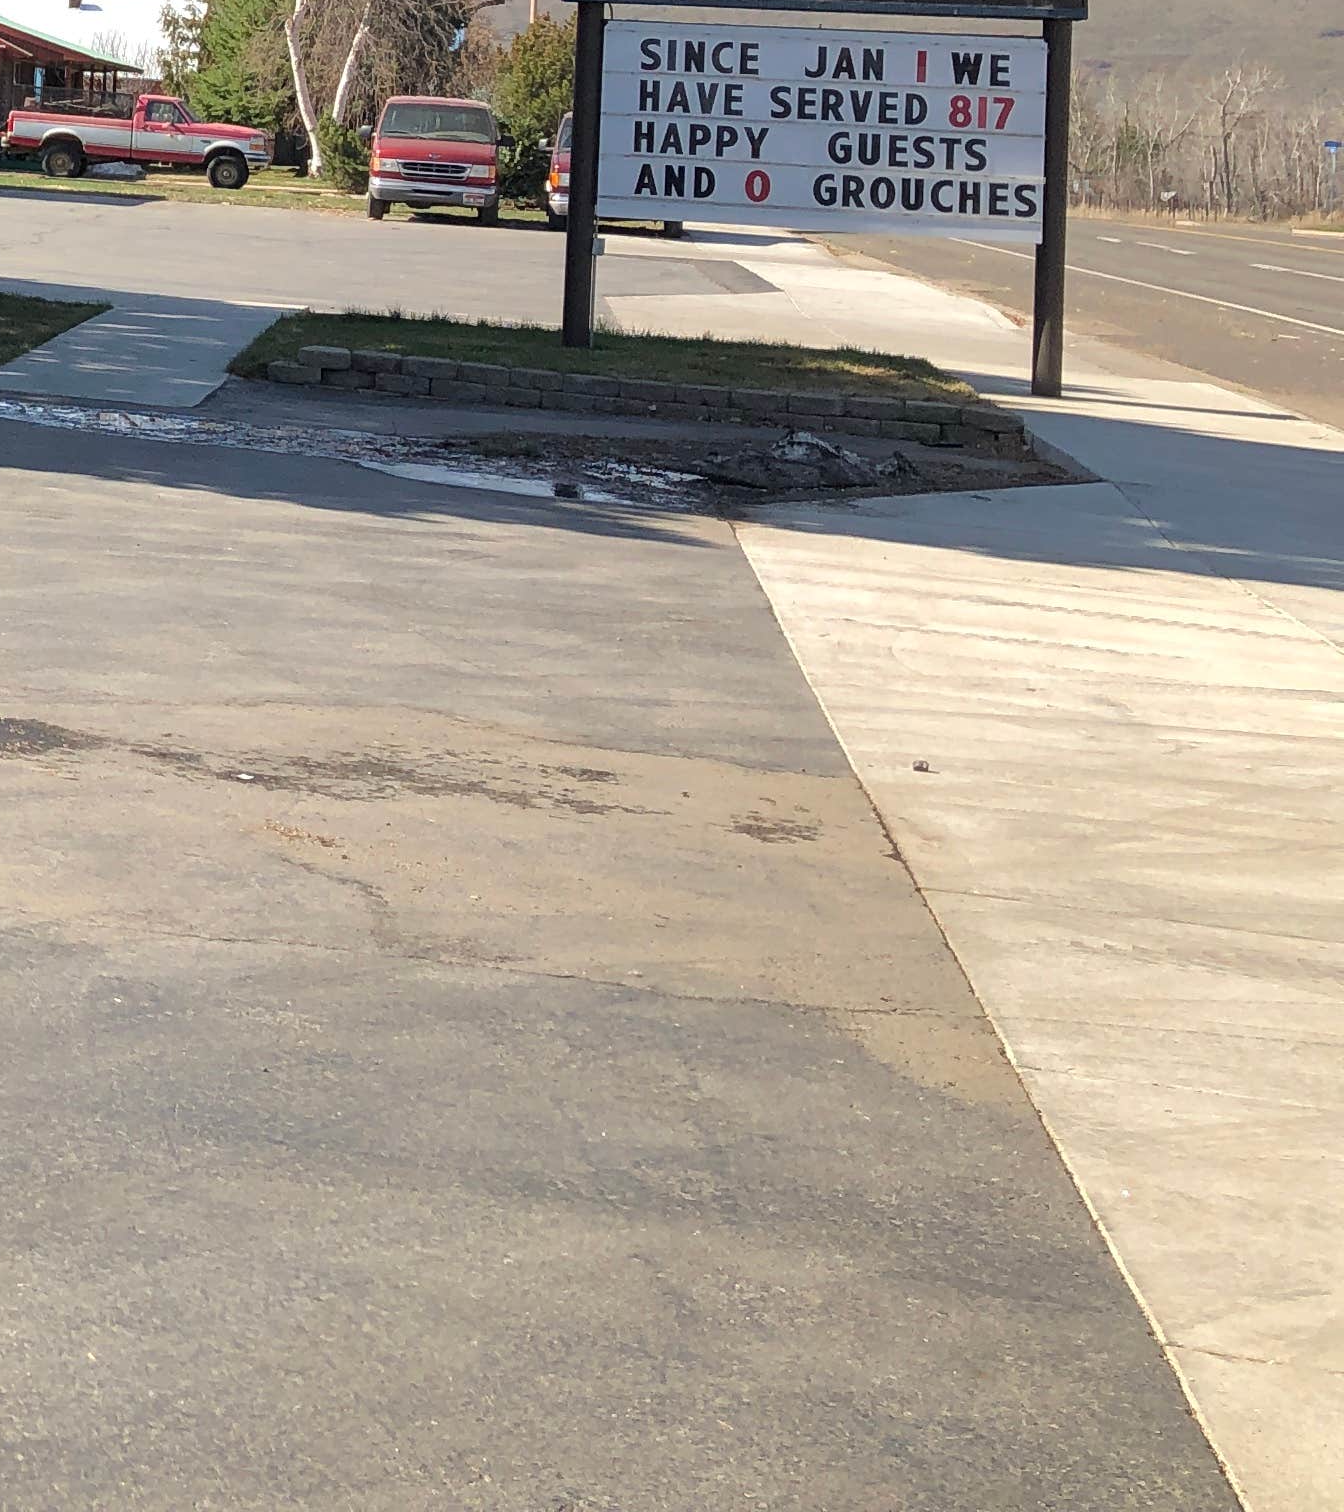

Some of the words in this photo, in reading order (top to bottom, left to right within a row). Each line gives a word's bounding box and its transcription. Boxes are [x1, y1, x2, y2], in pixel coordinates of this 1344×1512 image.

[639, 37, 760, 76] SINCE
[804, 45, 885, 81] JAN
[951, 51, 1012, 88] WE
[638, 79, 745, 117] HAVE
[770, 86, 929, 125] SERVED
[947, 95, 1016, 131] 817
[632, 120, 769, 161] HAPPY
[827, 131, 988, 172] GUESTS
[633, 163, 717, 200] AND
[812, 172, 1038, 219] GROUCHES
